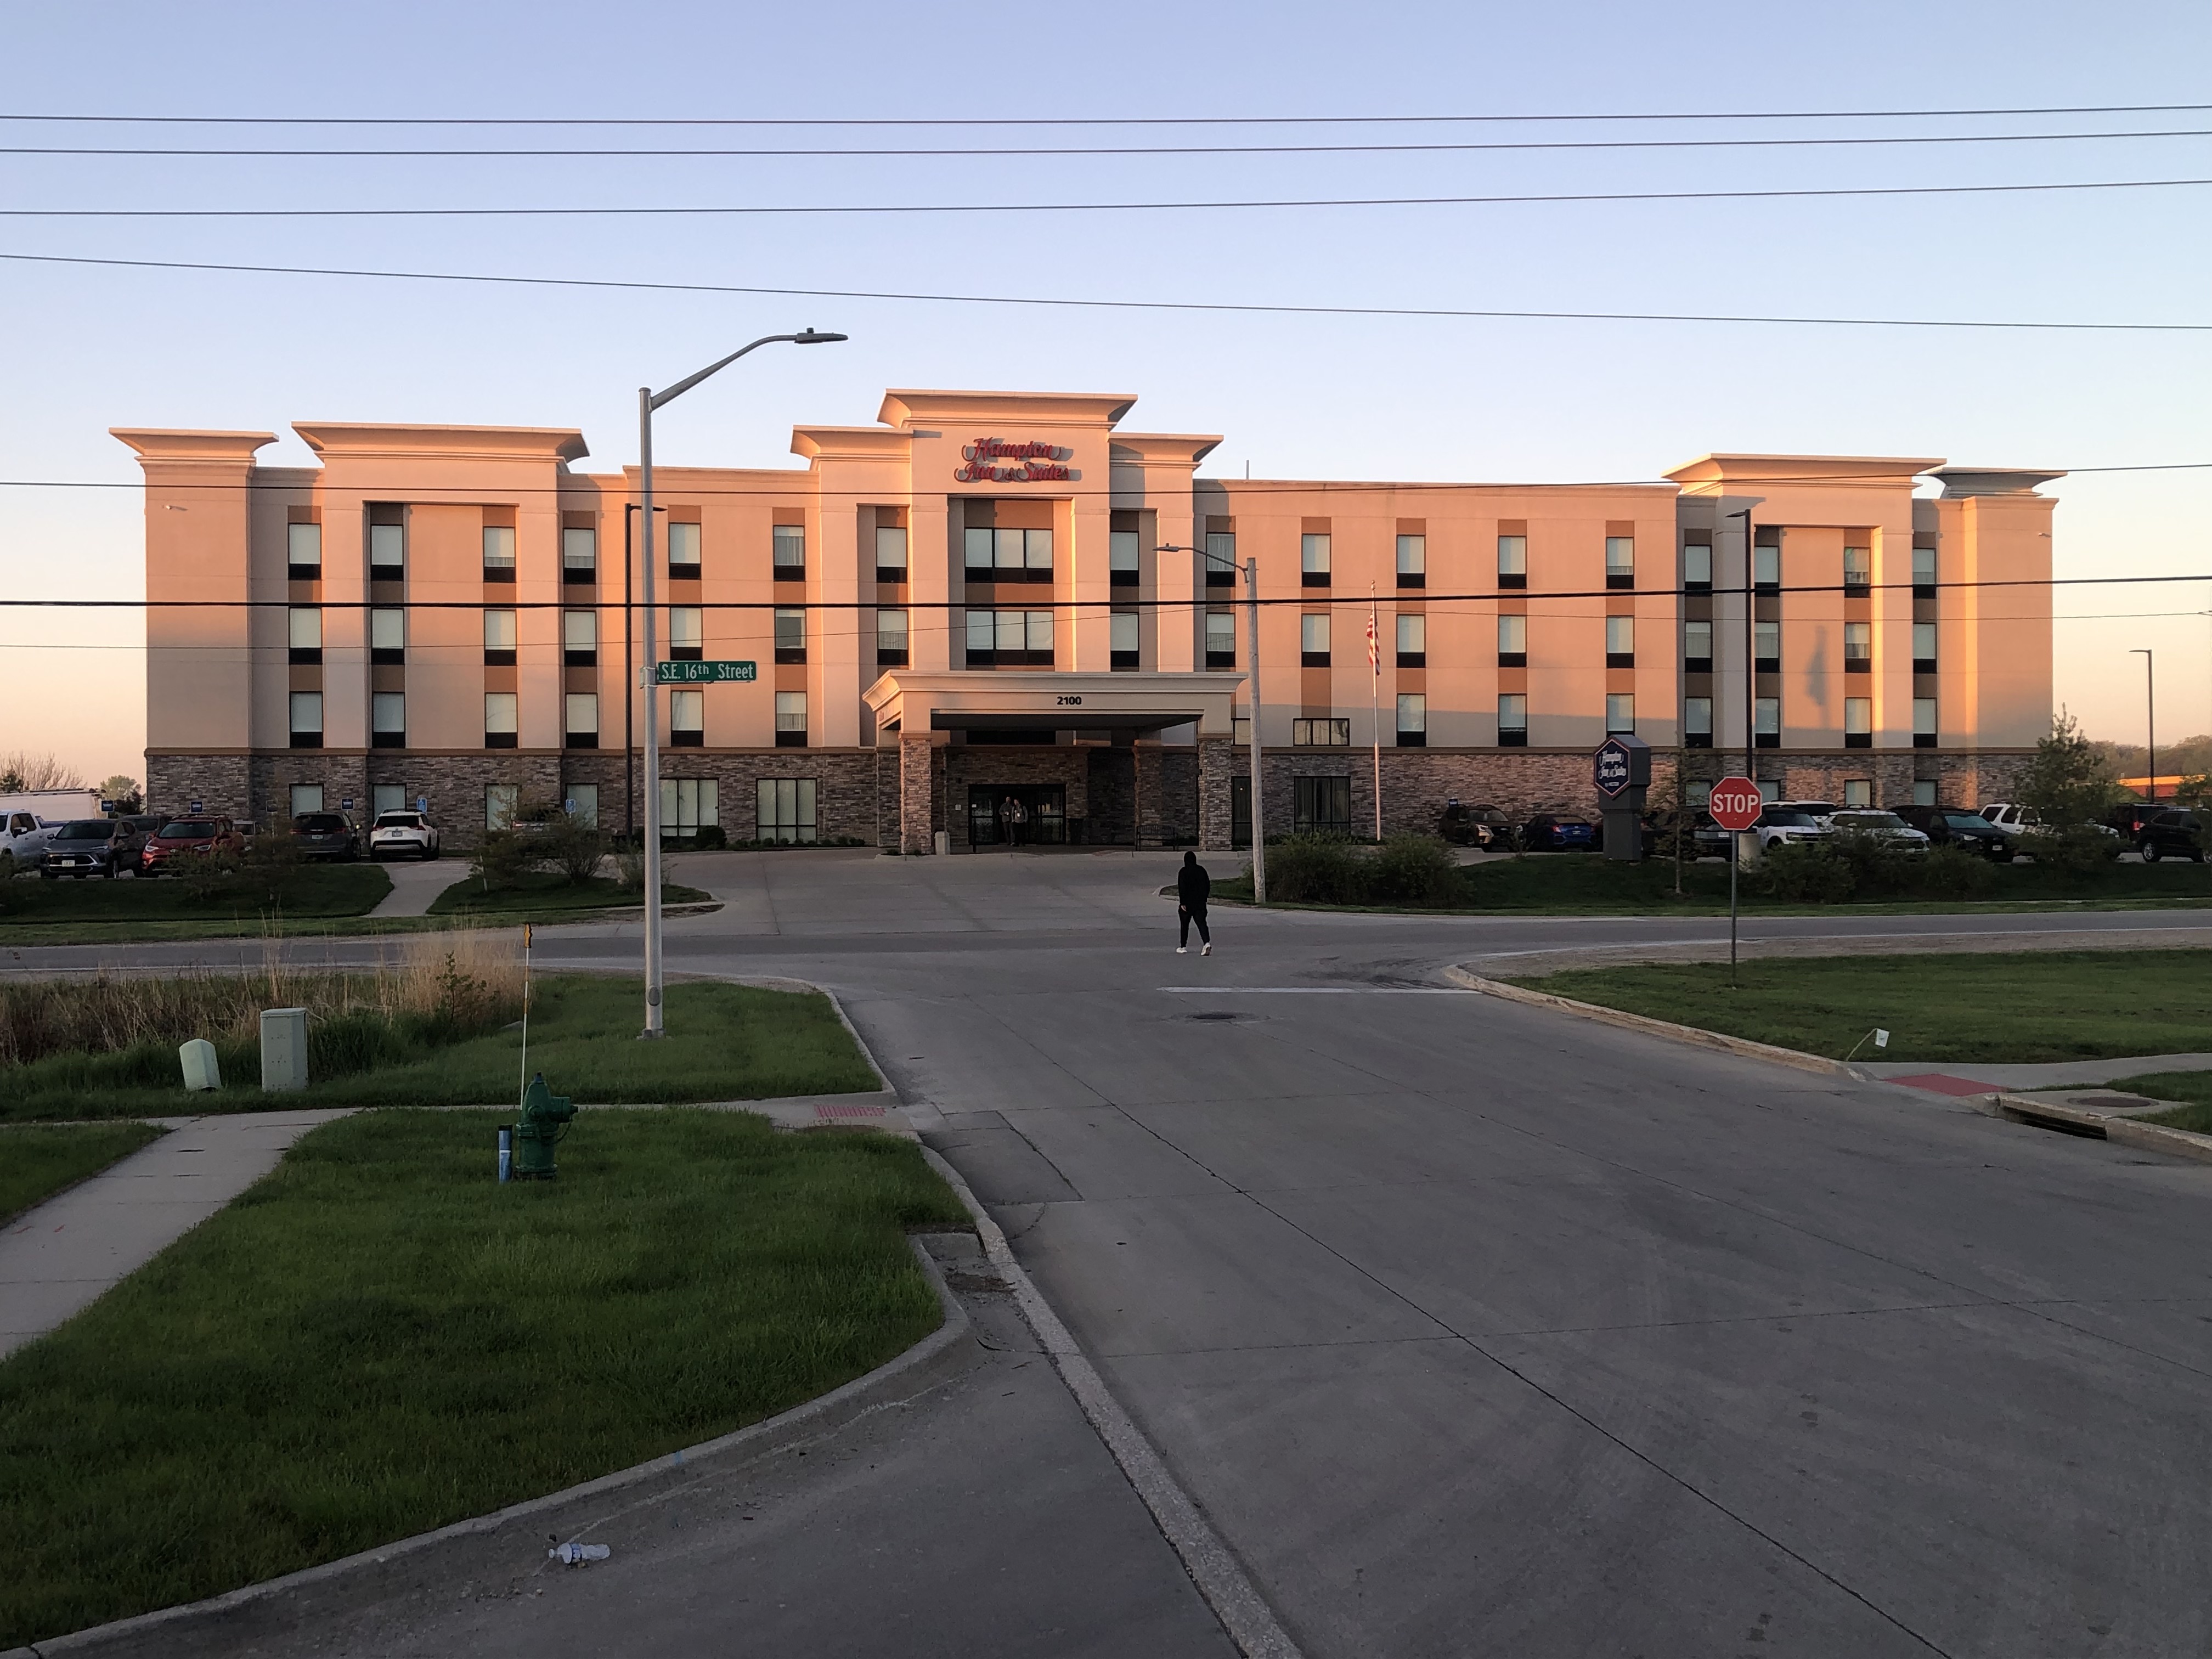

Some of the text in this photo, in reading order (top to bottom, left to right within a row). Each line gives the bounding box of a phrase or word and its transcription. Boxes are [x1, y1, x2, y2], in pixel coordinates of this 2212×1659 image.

[961, 437, 1062, 461] Hampton
[953, 461, 1004, 482] Inn
[1017, 461, 1069, 481] Suites
[662, 663, 753, 679] S.E. 16th Street
[1057, 696, 1082, 705] 2100
[1713, 793, 1759, 813] STOP
